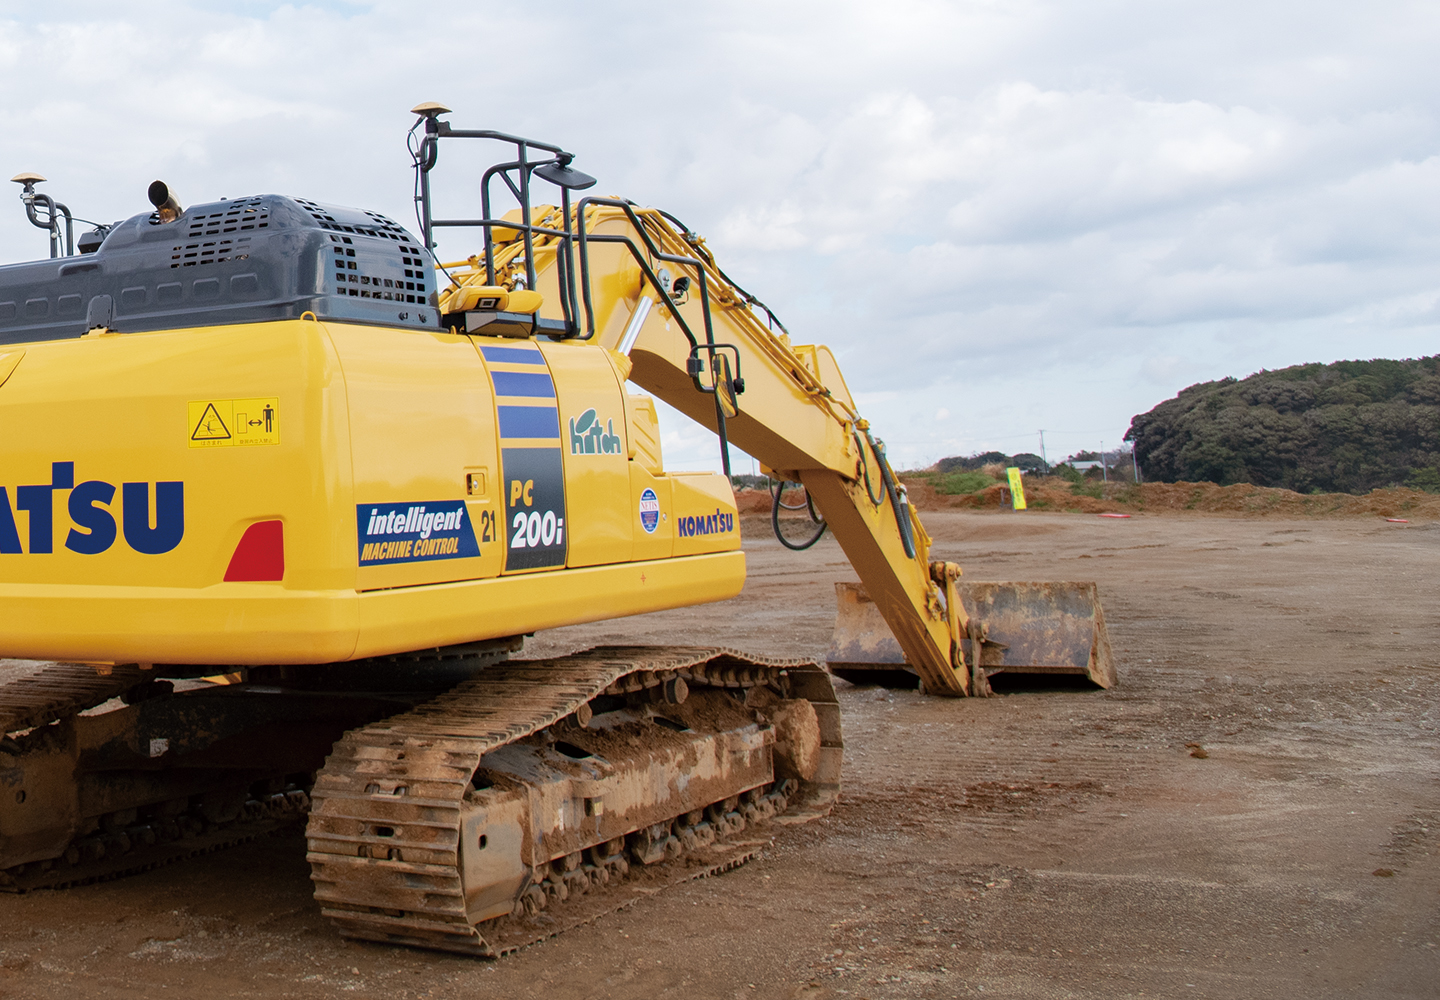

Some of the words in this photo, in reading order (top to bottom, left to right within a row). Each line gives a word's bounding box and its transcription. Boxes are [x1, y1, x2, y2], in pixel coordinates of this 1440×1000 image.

[510, 479, 534, 507] PC
[367, 506, 463, 539] intelligent
[481, 509, 496, 542] 21
[510, 510, 563, 549] 200i
[678, 508, 733, 537] KOMATSU
[361, 540, 413, 561] MACHINE
[413, 537, 459, 557] CONTROL
